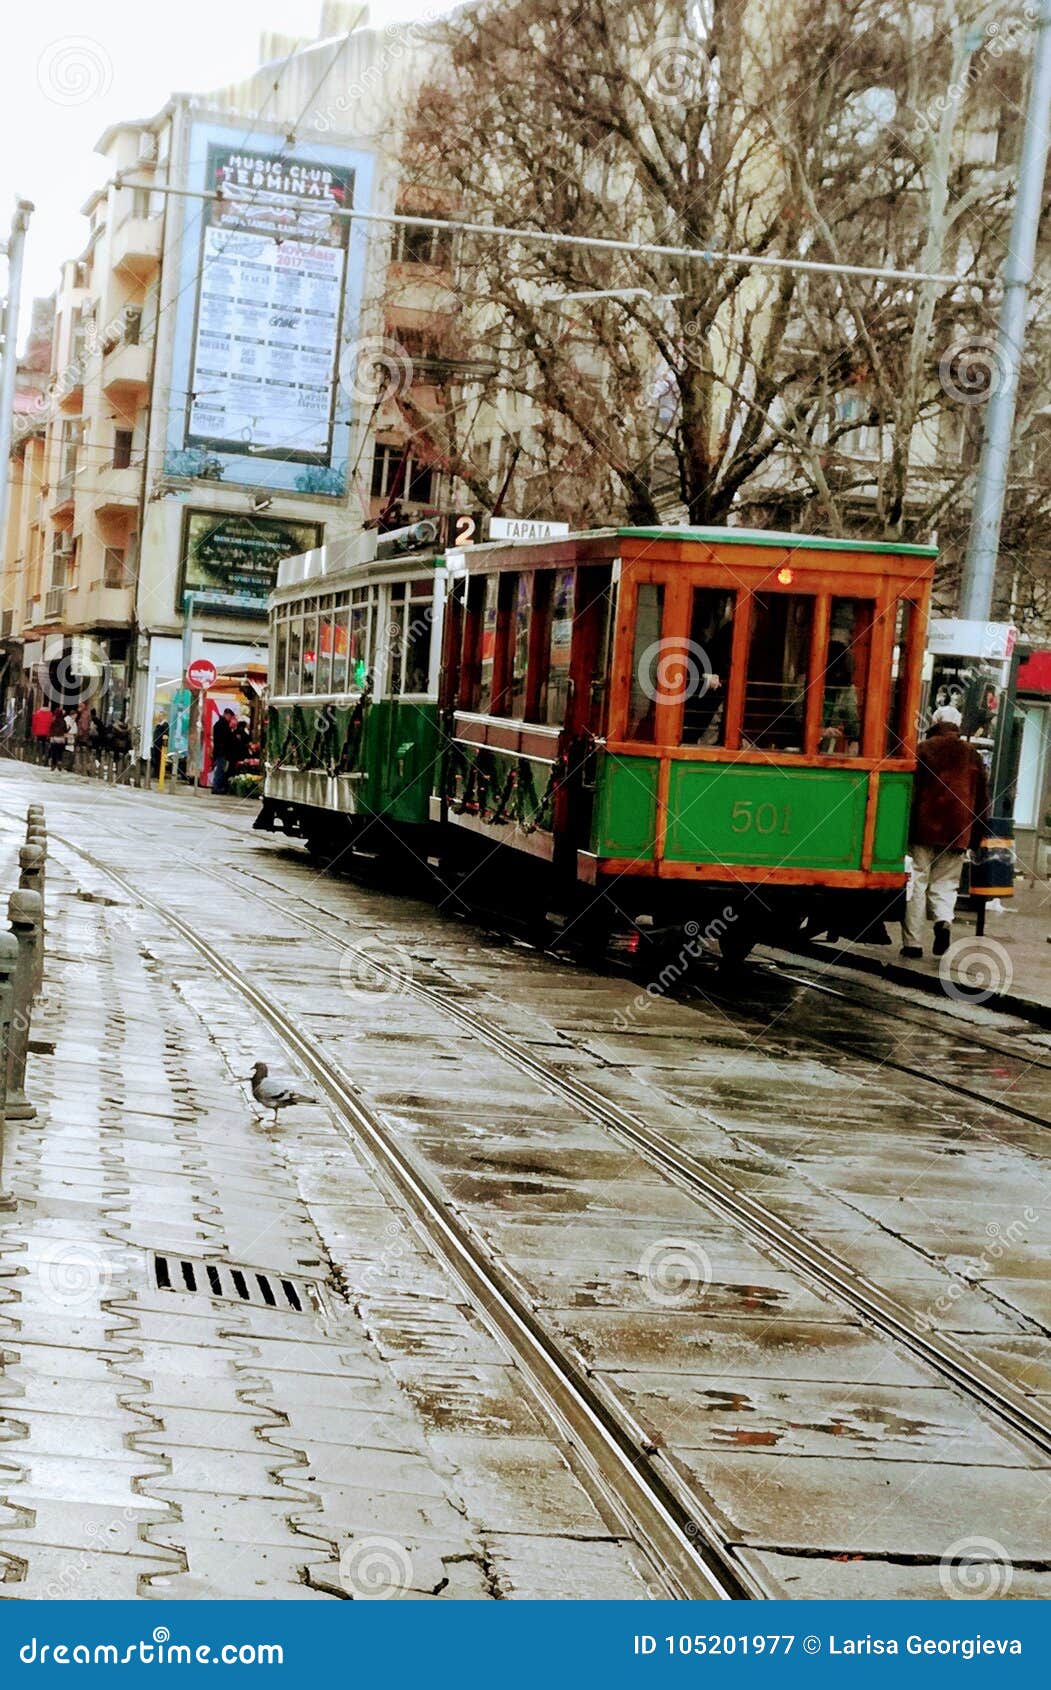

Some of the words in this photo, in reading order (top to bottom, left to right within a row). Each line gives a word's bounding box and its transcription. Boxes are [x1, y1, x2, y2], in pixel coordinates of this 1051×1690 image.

[222, 165, 335, 199] TERMINAL
[229, 155, 282, 174] MUSIC
[290, 166, 332, 183] CLUB
[276, 254, 303, 267] 2017
[455, 516, 475, 546] 2
[506, 522, 551, 538] ГАРАТА
[731, 800, 792, 835] 501
